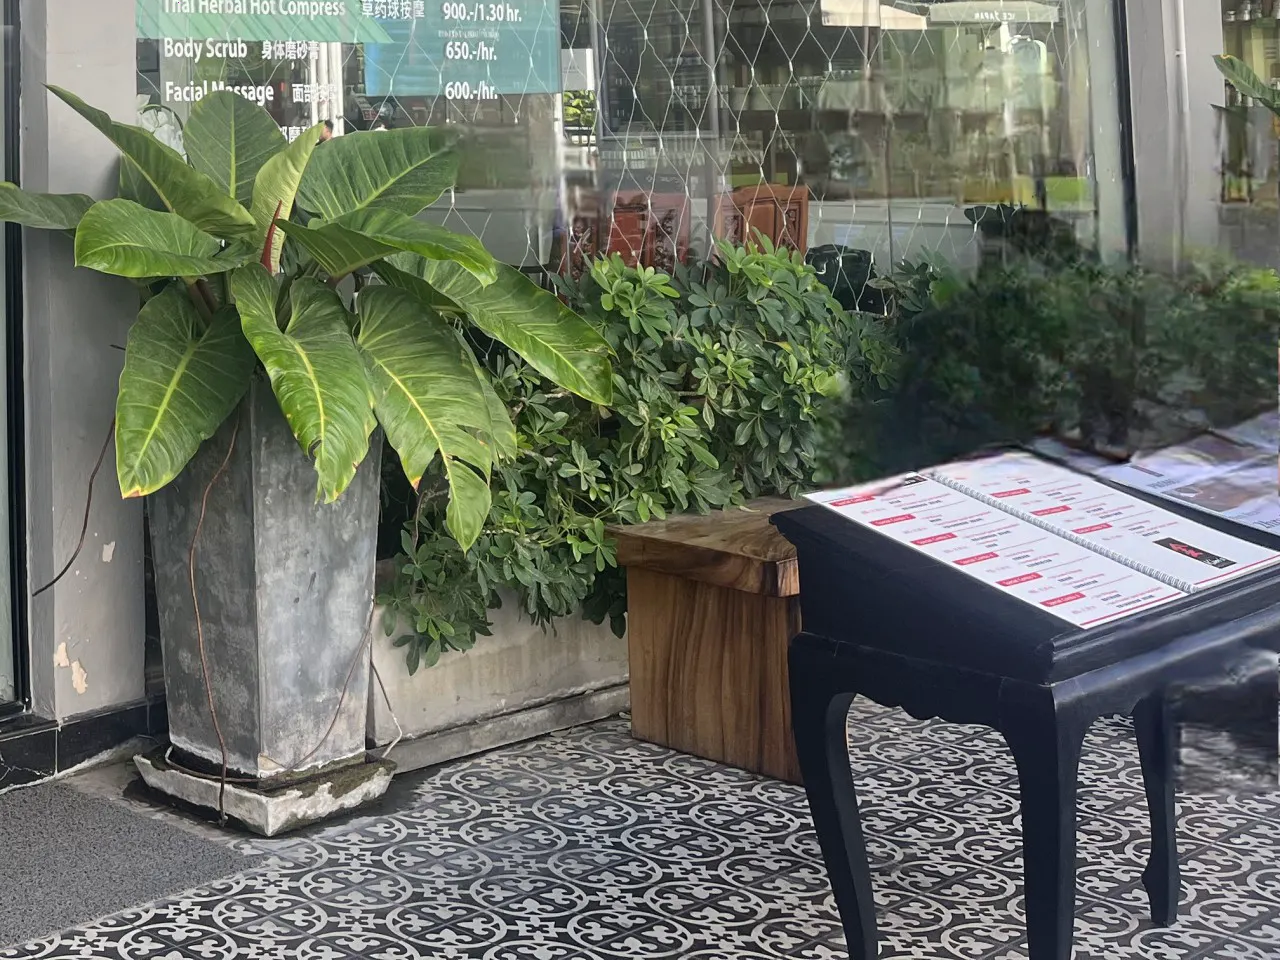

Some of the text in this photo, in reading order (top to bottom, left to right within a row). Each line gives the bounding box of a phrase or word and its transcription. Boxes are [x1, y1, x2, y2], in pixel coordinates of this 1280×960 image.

[442, 2, 522, 22] 900.-/1.30 hr.
[164, 37, 248, 63] Body Scrub
[446, 41, 497, 61] 650.-/hr.
[165, 81, 207, 102] Facial
[445, 80, 498, 100] 600.-/hr.
